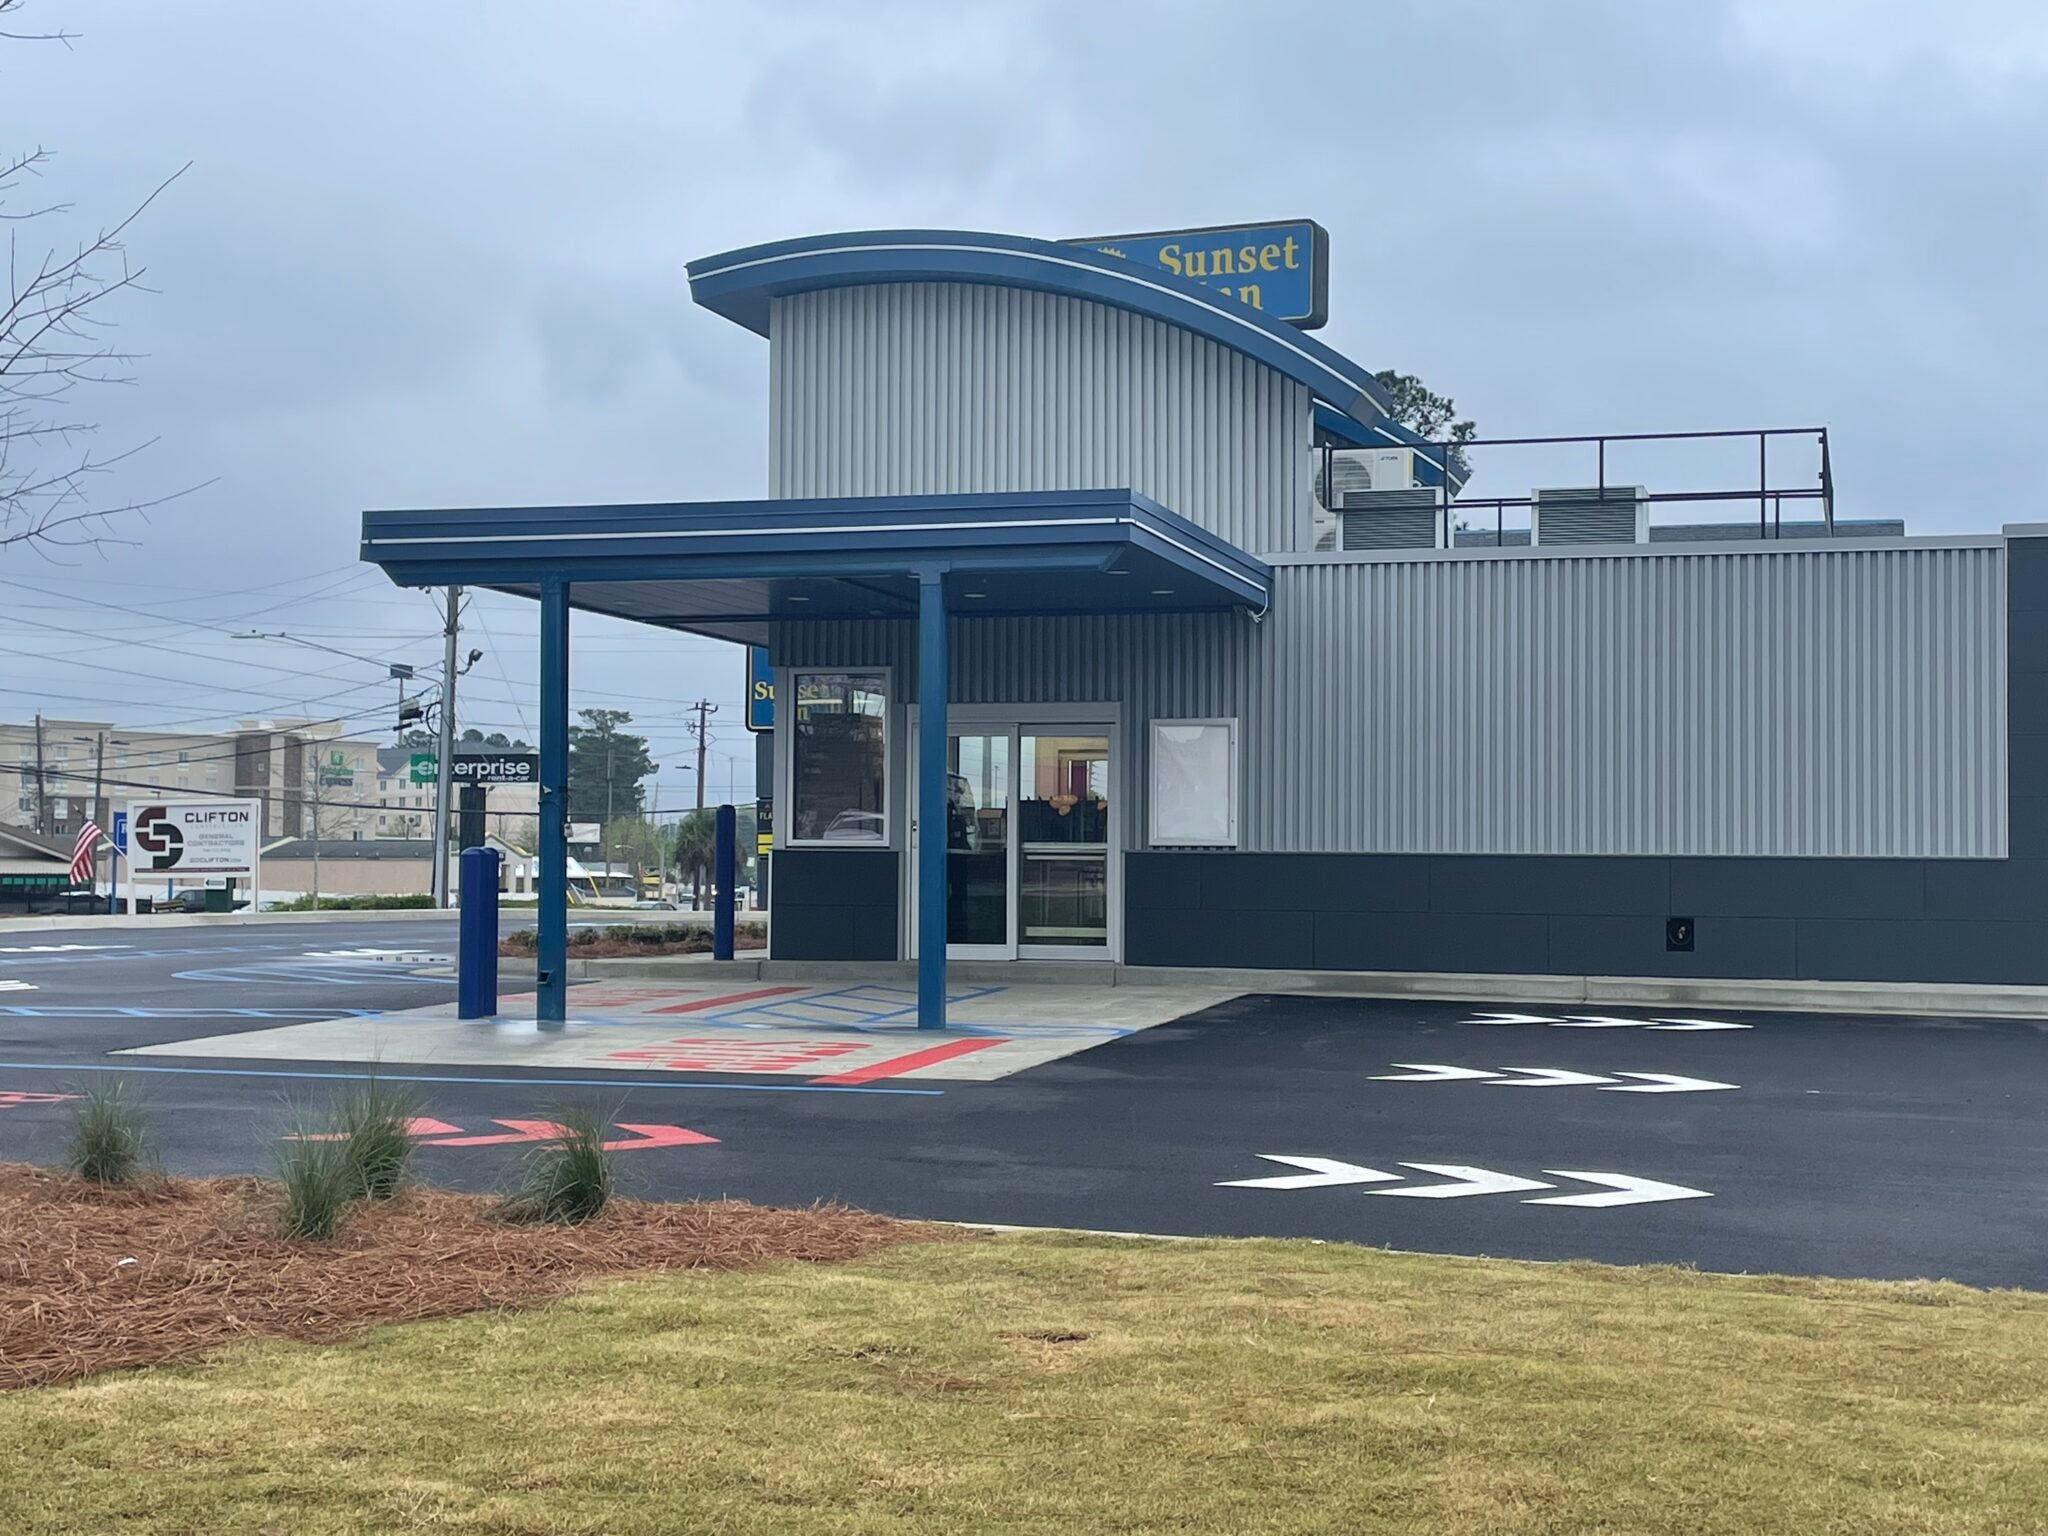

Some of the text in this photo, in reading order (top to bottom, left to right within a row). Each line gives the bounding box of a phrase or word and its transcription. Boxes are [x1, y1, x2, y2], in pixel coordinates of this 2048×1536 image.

[1159, 236, 1299, 277] Sunset
[412, 758, 531, 780] eerprise
[184, 811, 249, 823] CLIFTON
[759, 812, 774, 820] FLA
